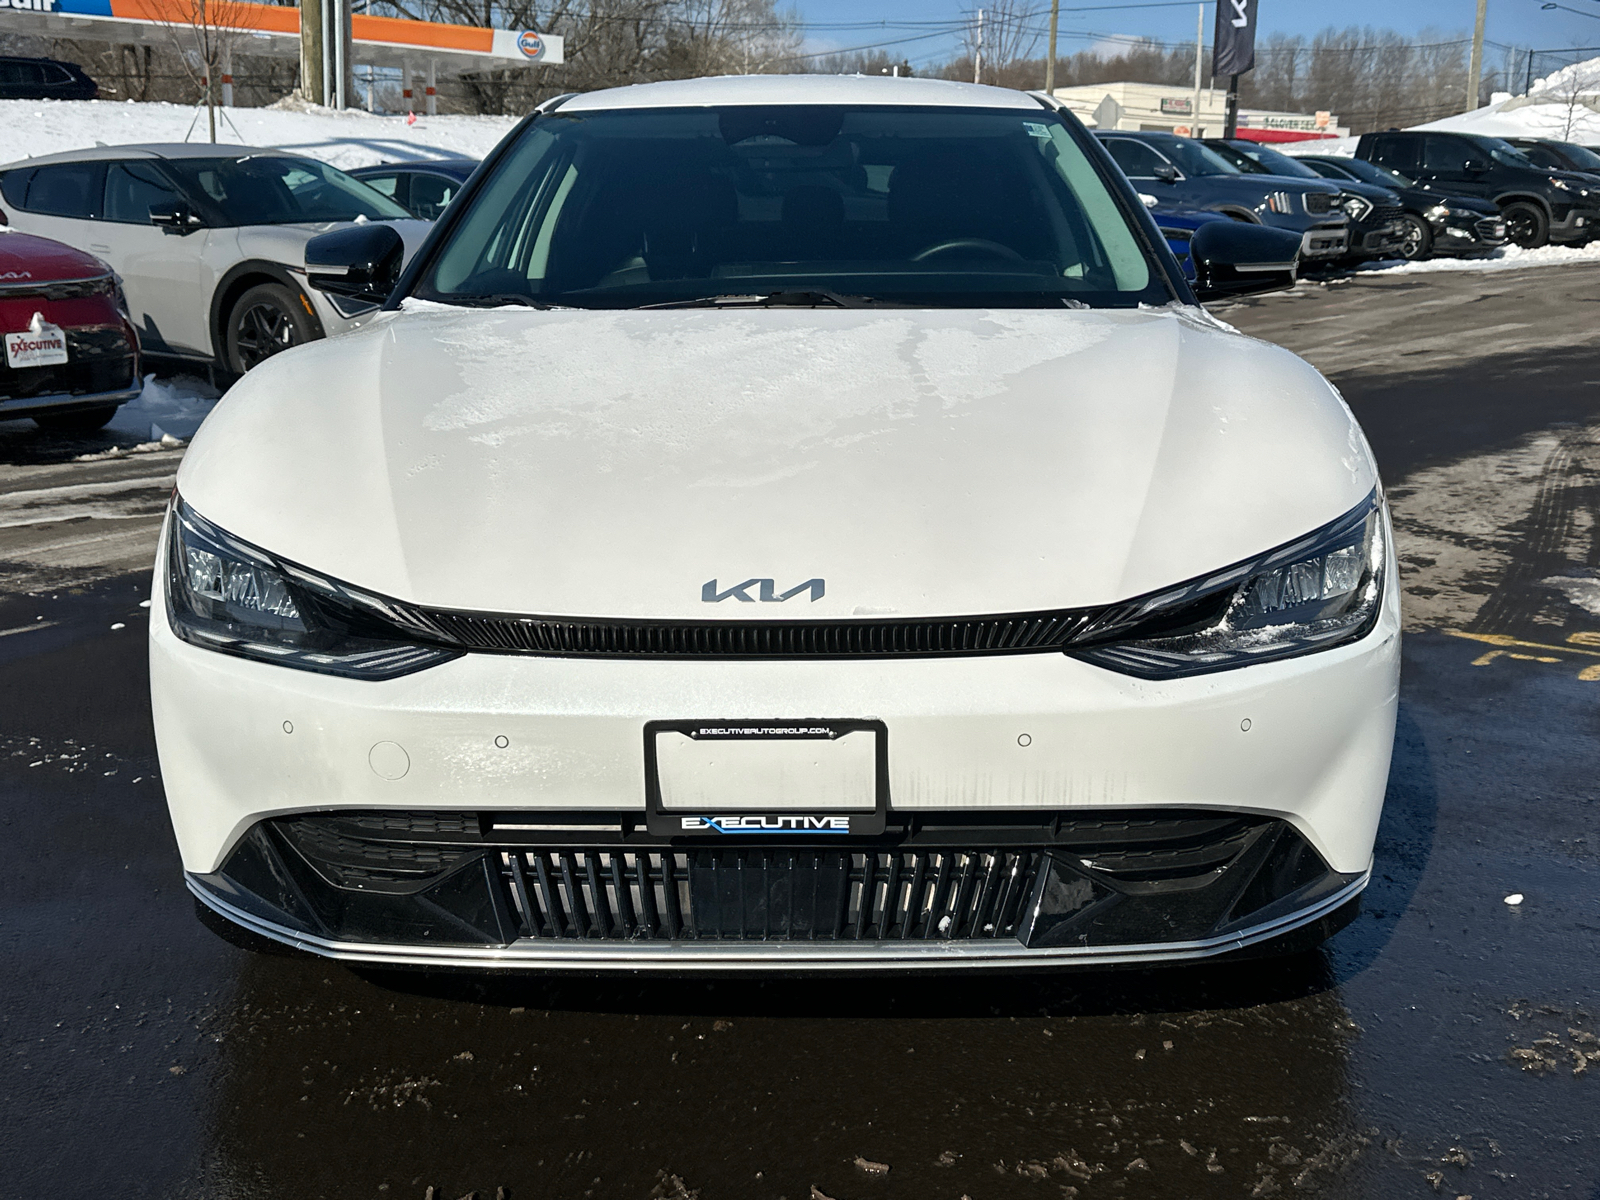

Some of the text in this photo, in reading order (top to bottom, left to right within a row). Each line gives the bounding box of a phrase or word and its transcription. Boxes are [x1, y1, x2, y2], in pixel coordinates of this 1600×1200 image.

[521, 39, 540, 49] Gulf
[10, 339, 62, 358] EXECUTIVE
[701, 578, 825, 603] KIA
[681, 816, 850, 831] EXECUTIVE
